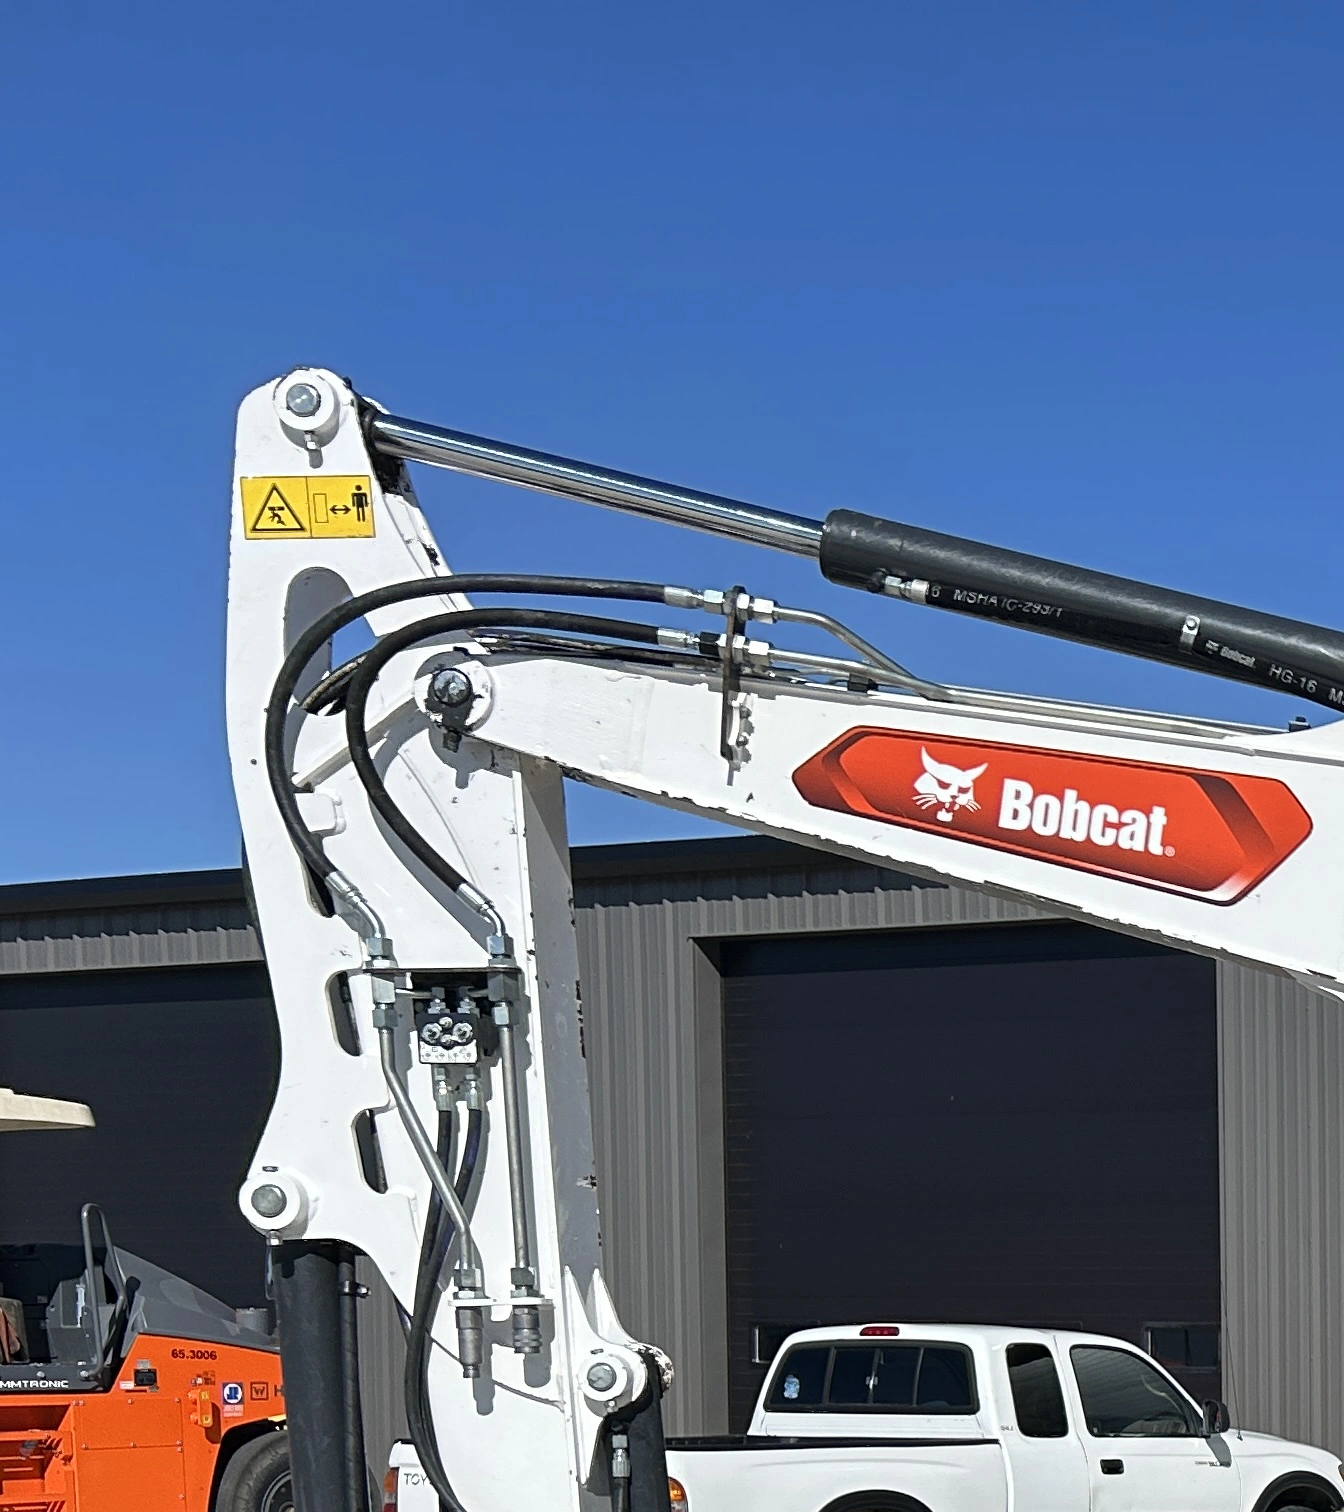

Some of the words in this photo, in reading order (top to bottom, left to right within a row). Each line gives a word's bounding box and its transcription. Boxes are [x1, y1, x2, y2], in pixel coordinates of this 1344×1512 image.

[1268, 663, 1318, 693] HG-16
[998, 777, 1168, 857] Bobcat
[403, 1473, 433, 1486] TOY
